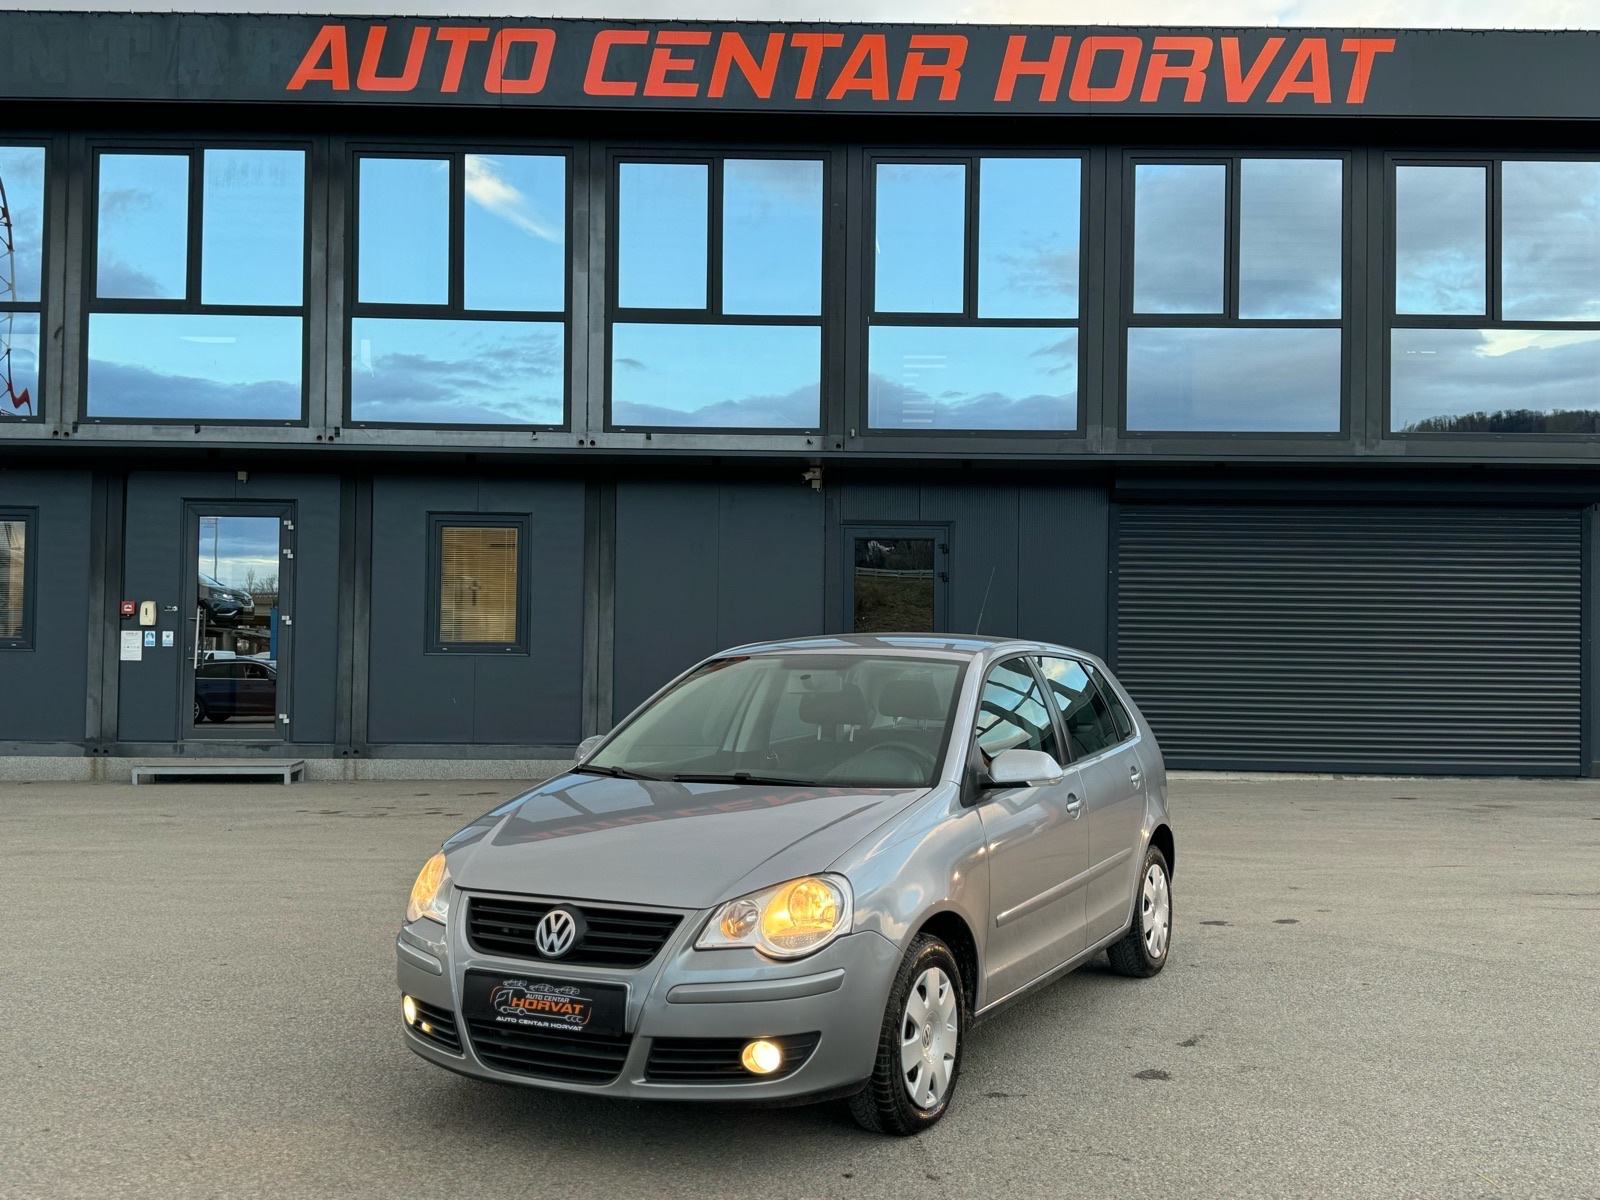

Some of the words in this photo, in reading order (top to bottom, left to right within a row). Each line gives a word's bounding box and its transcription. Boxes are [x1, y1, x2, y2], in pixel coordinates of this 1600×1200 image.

[286, 25, 556, 94] AUTO
[583, 30, 968, 101] CENTAR
[994, 35, 1396, 104] HORVAT
[536, 910, 575, 957] VW
[511, 997, 584, 1014] HORVAT
[544, 995, 569, 1003] CENTAR
[518, 1019, 548, 1027] CENTAR
[550, 1023, 583, 1031] HORVAT
